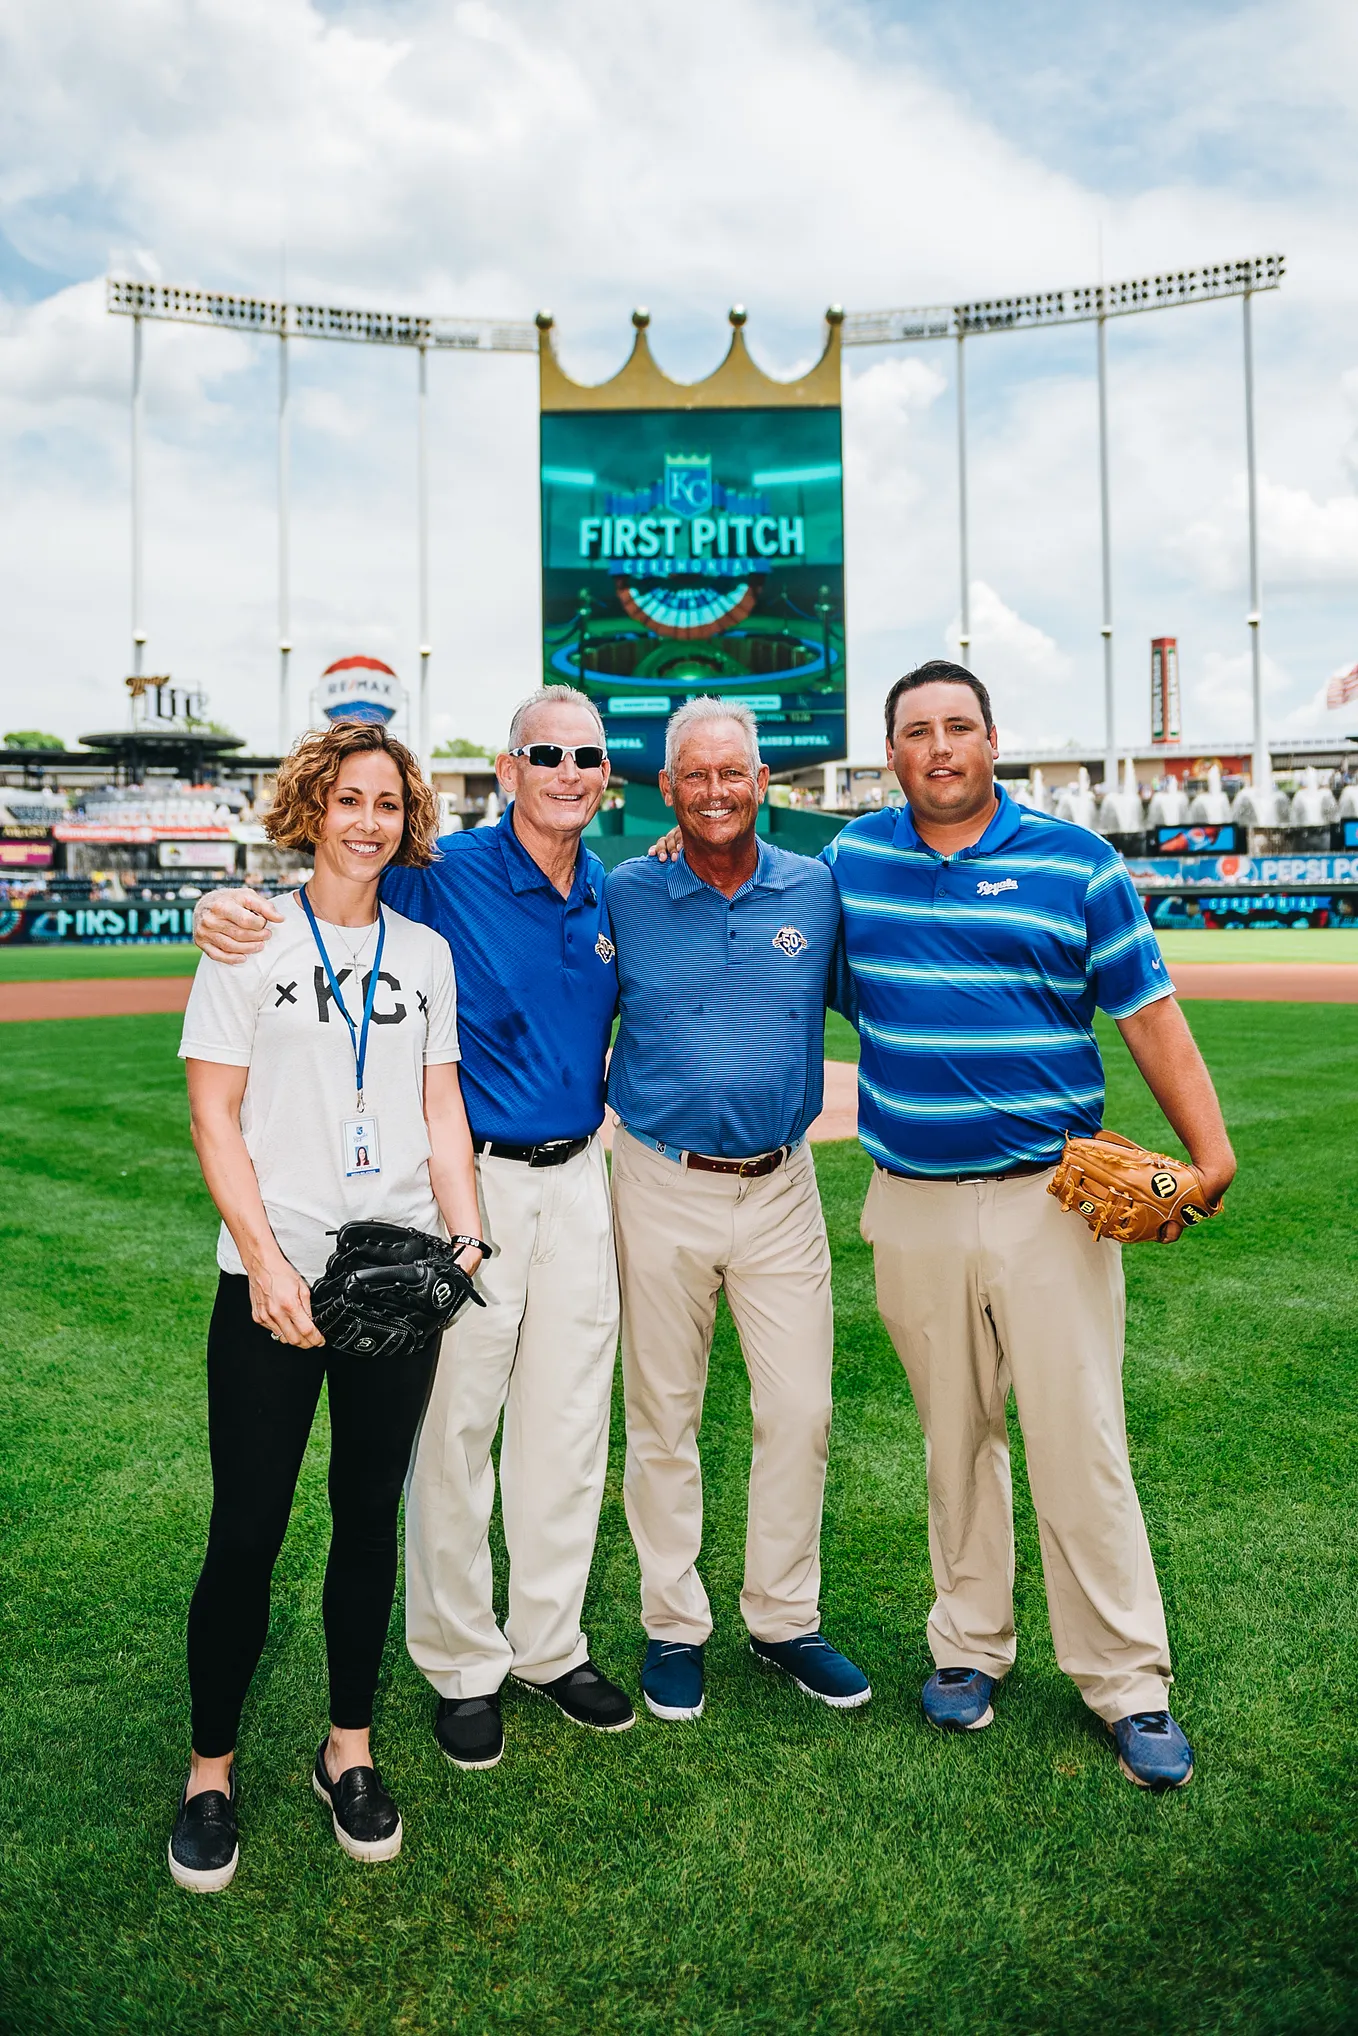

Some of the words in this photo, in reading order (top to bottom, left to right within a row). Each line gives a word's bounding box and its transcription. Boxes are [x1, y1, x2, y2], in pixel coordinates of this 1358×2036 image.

[670, 471, 708, 508] KC
[579, 517, 682, 557] FIRST
[692, 515, 805, 557] PITCH
[623, 558, 757, 575] CEREMONIAL
[328, 679, 391, 696] RE/MAX
[1261, 859, 1328, 880] PEPSI
[976, 878, 1019, 896] Royals
[1208, 896, 1317, 912] CEREMONIAL
[782, 933, 799, 948] 50
[314, 965, 408, 1028] KC
[457, 1236, 470, 1244] ACE
[470, 1239, 480, 1247] 30
